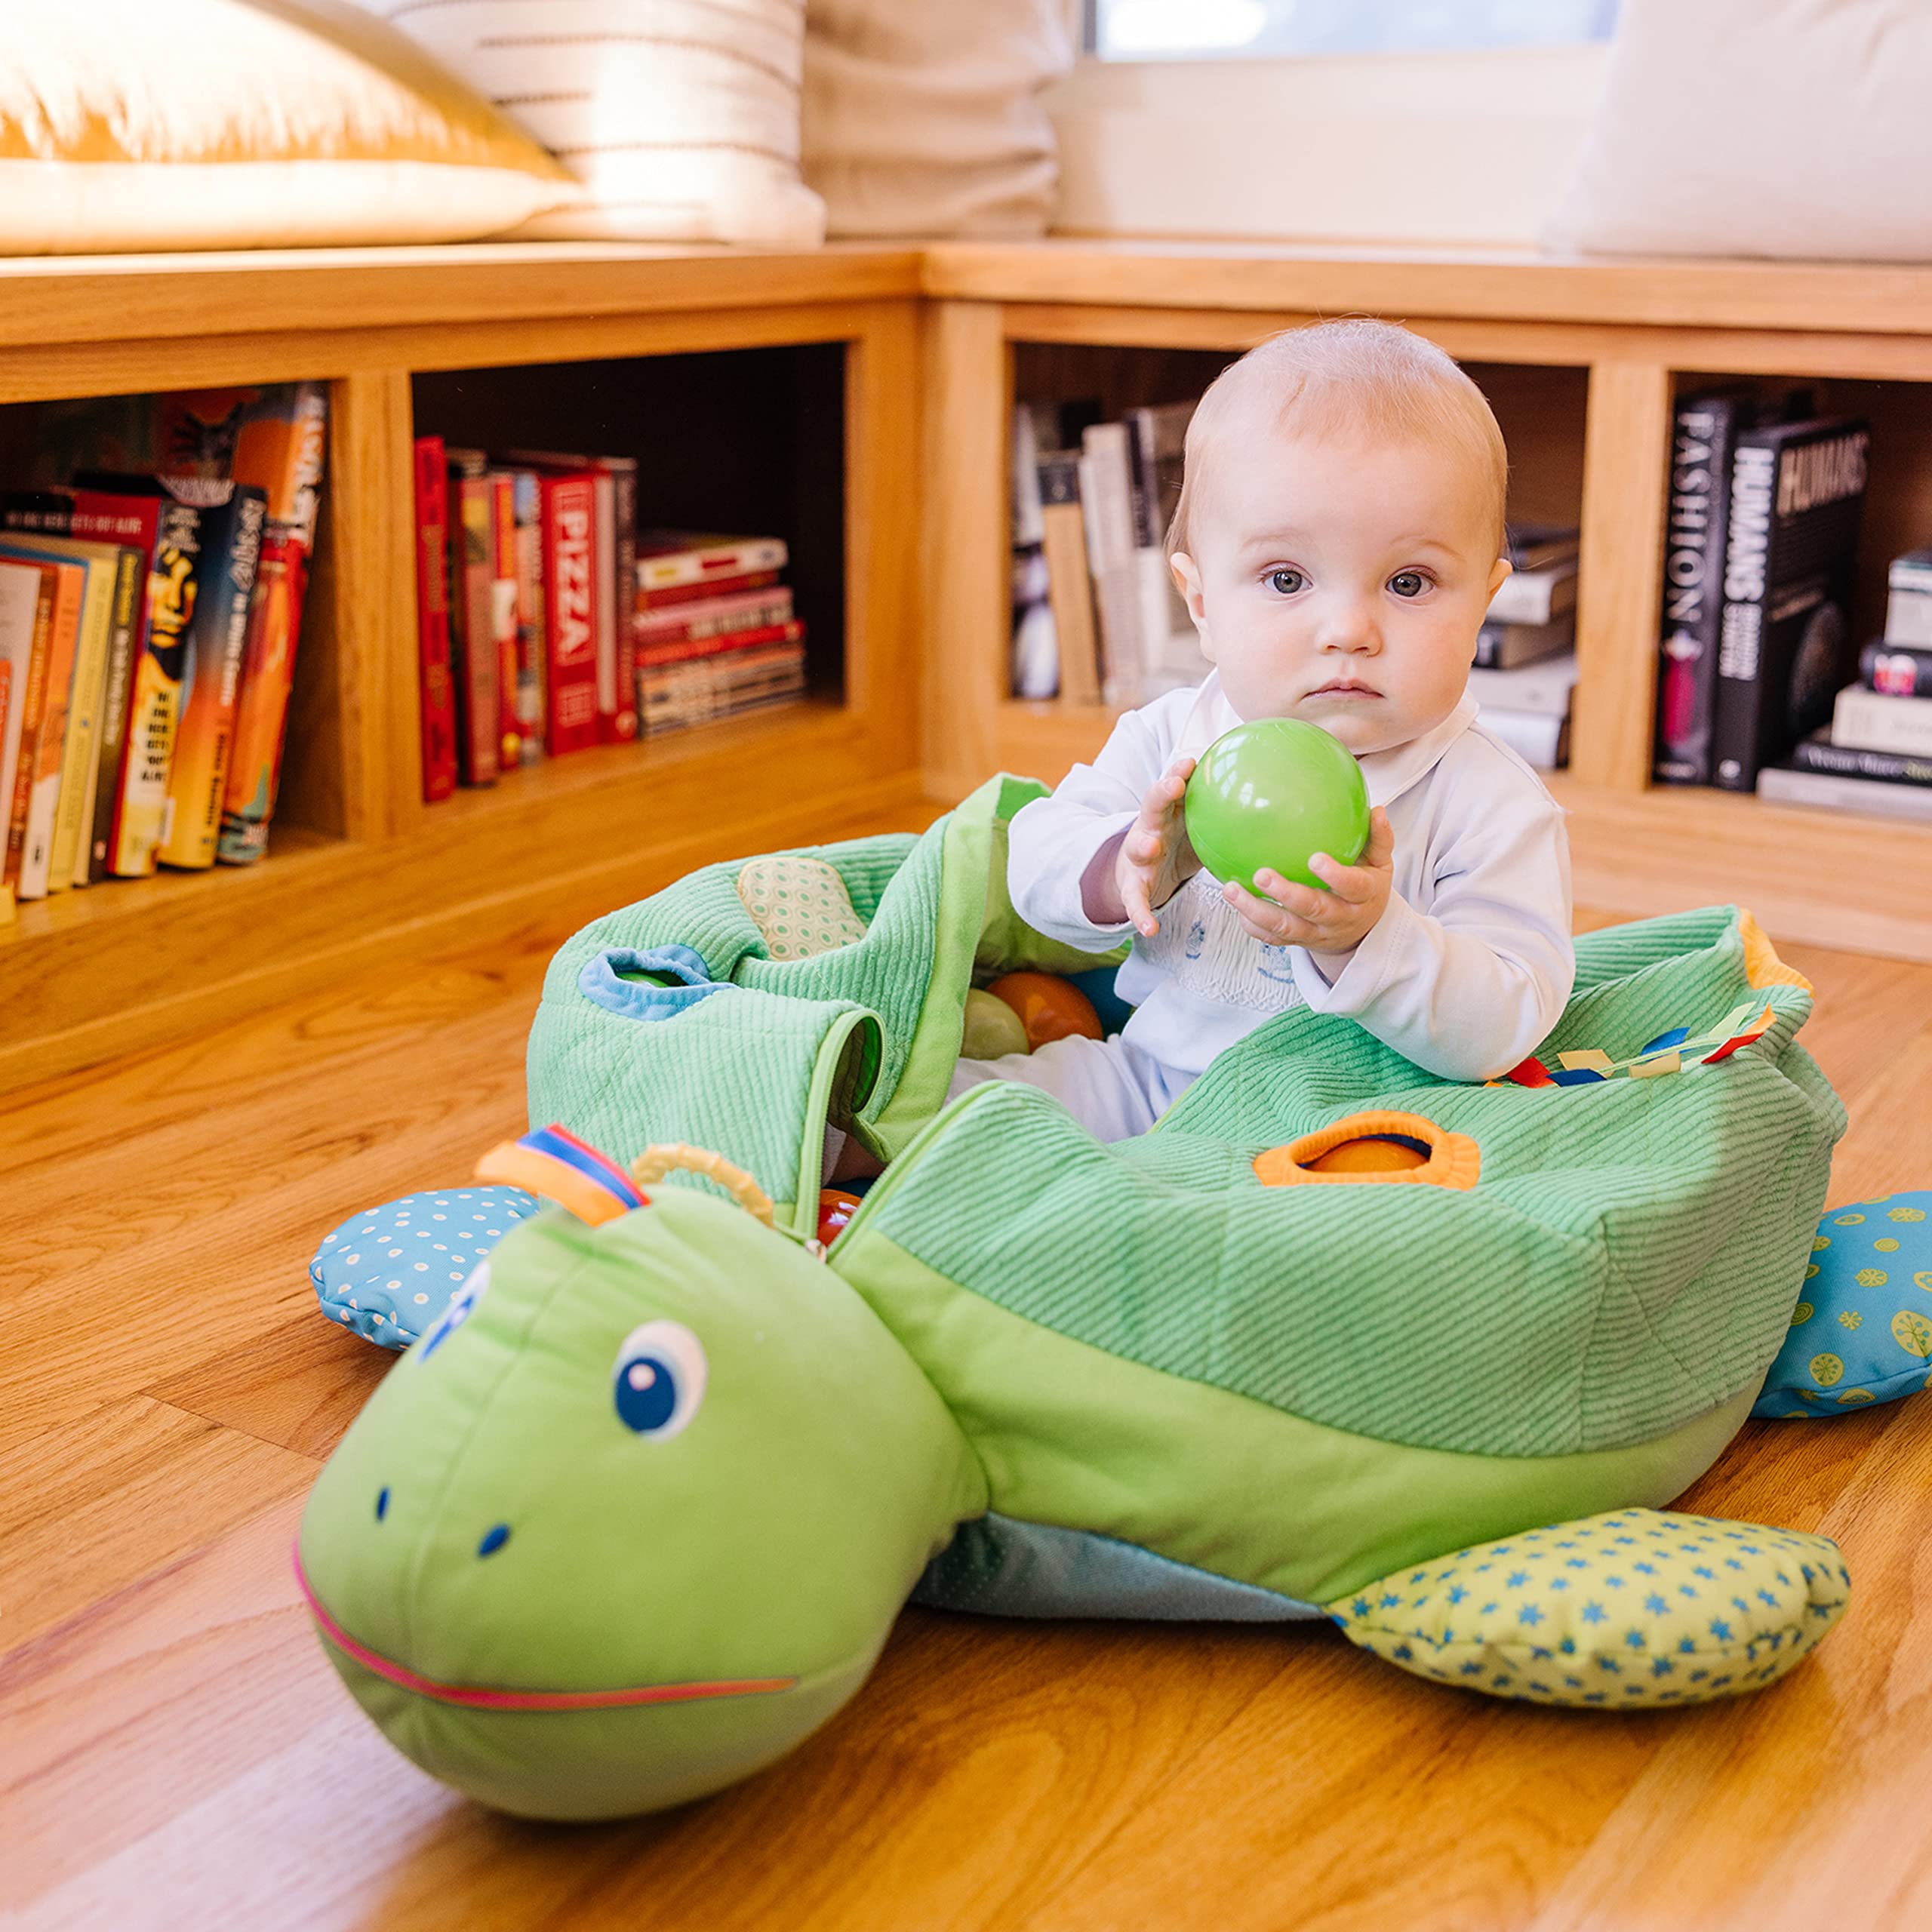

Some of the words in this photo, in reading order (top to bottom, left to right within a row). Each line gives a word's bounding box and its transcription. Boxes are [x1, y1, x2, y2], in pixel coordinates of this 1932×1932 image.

[555, 511, 589, 654] PIZZA
[1666, 411, 1714, 623] FASHION
[1724, 448, 1774, 602] HUMANS
